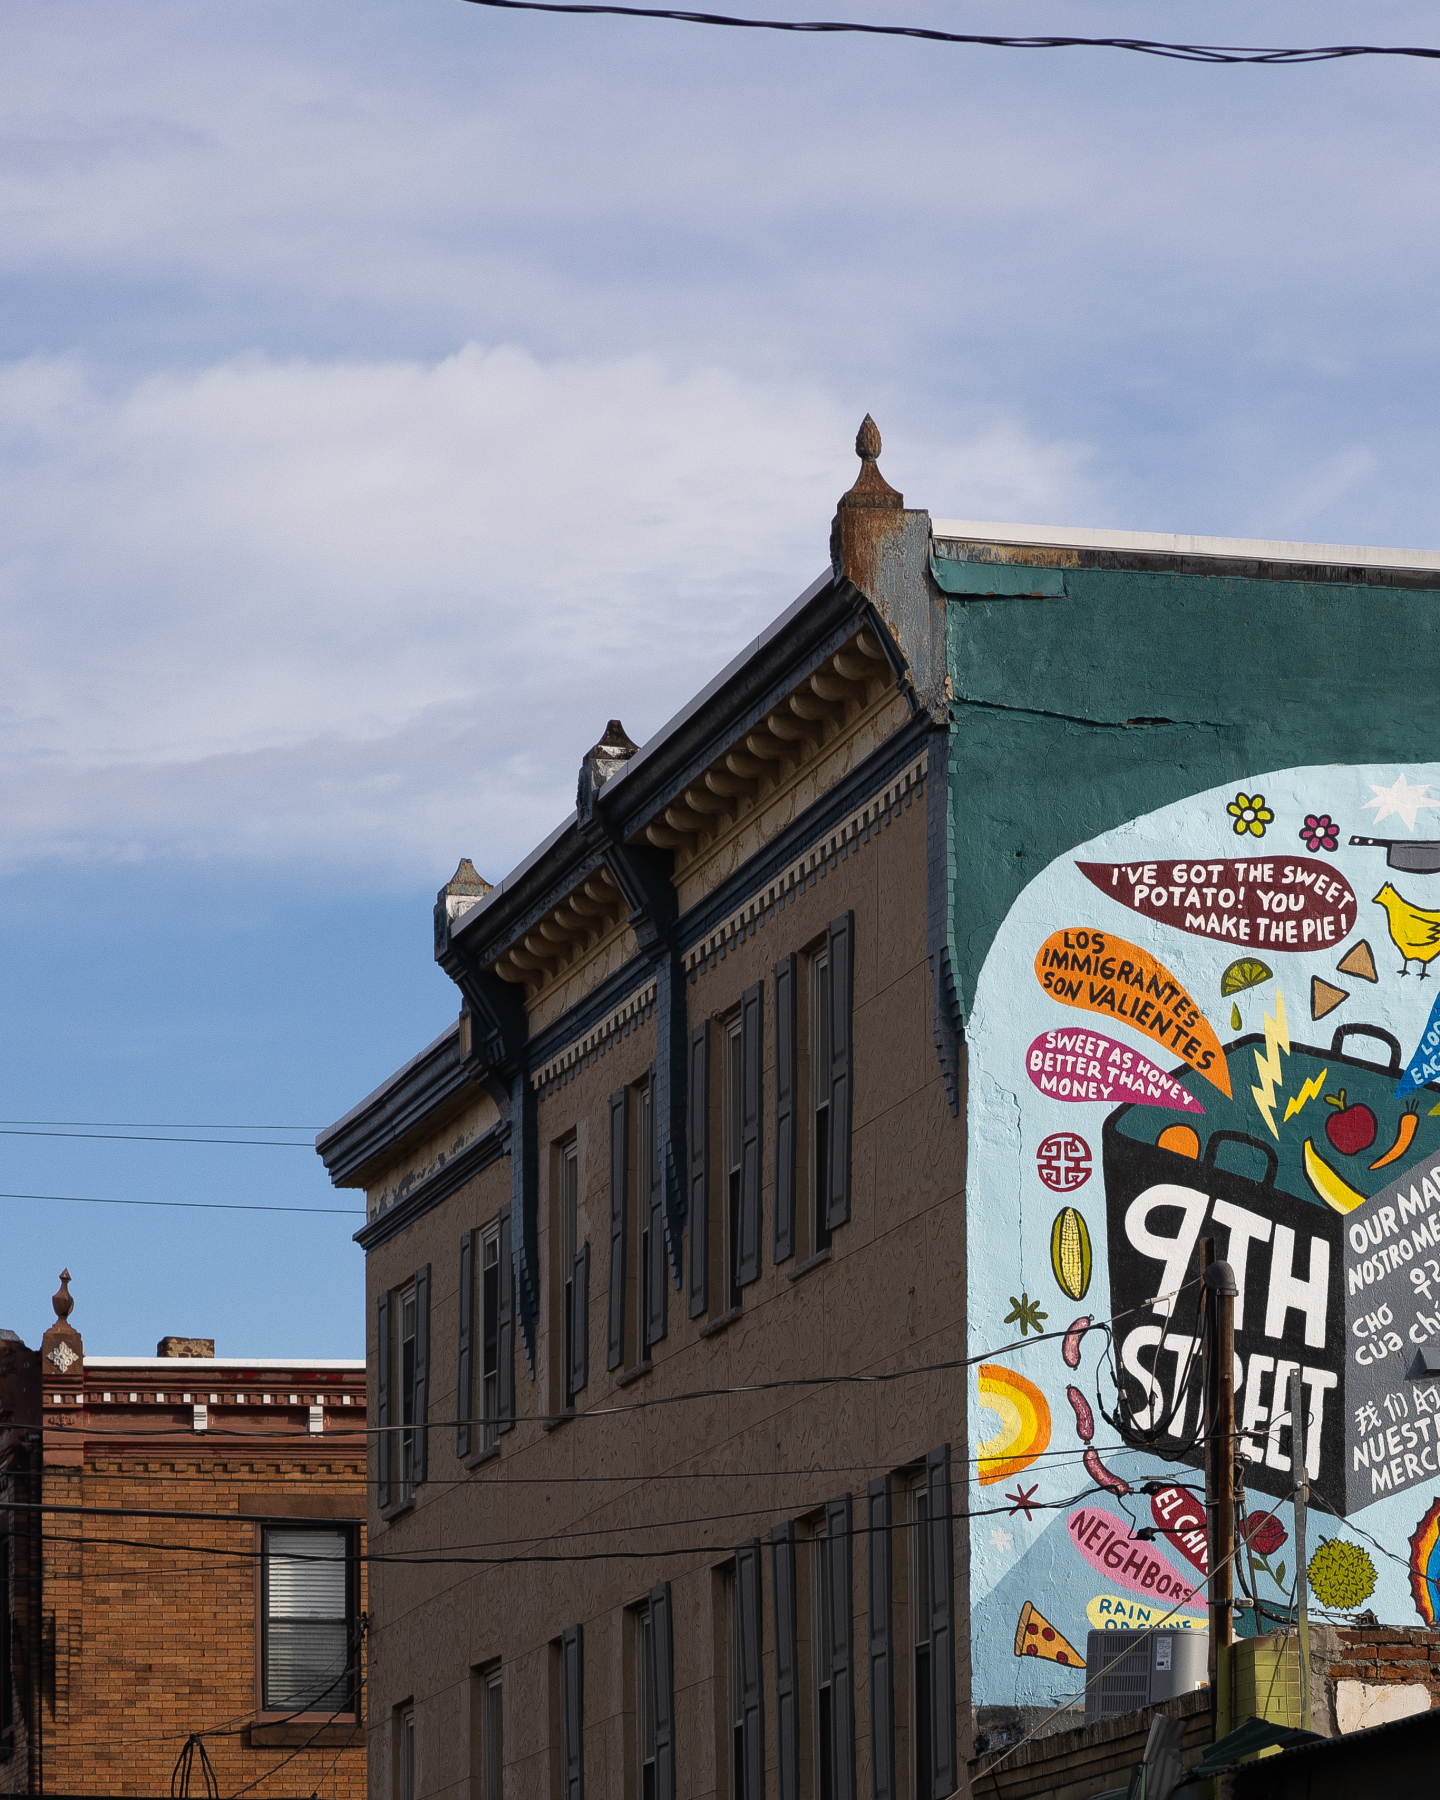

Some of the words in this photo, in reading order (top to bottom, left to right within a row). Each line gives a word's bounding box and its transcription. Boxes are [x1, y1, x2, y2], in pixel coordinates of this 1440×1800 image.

[1112, 864, 1157, 886] I'VE
[1172, 865, 1223, 883] GOT
[1235, 863, 1274, 883] THE
[1283, 866, 1355, 910] SWEET
[1133, 887, 1244, 908] POTATO!
[1257, 890, 1305, 912] YOU
[1063, 932, 1105, 954] LOS
[1186, 912, 1251, 940] MAKE
[1258, 918, 1298, 943] THE
[1042, 949, 1199, 1028] IMMIGRANTES
[1044, 972, 1080, 1000] SON
[1089, 980, 1216, 1069] VALIENTES
[1030, 1053, 1101, 1077] BETTER
[1107, 1067, 1162, 1098] THAN
[1040, 1076, 1112, 1099] MONEY
[1045, 1032, 1104, 1058] SWEET
[1110, 1048, 1132, 1066] AS
[1137, 1060, 1194, 1105] HONEY
[1349, 1205, 1399, 1254] OUR
[1125, 1184, 1330, 1348] 9TH
[1348, 1238, 1413, 1295] NOSTRO
[1155, 1489, 1183, 1520] EL
[1070, 1510, 1193, 1602] NEIGHBORS
[1100, 1599, 1151, 1621] RAIN
